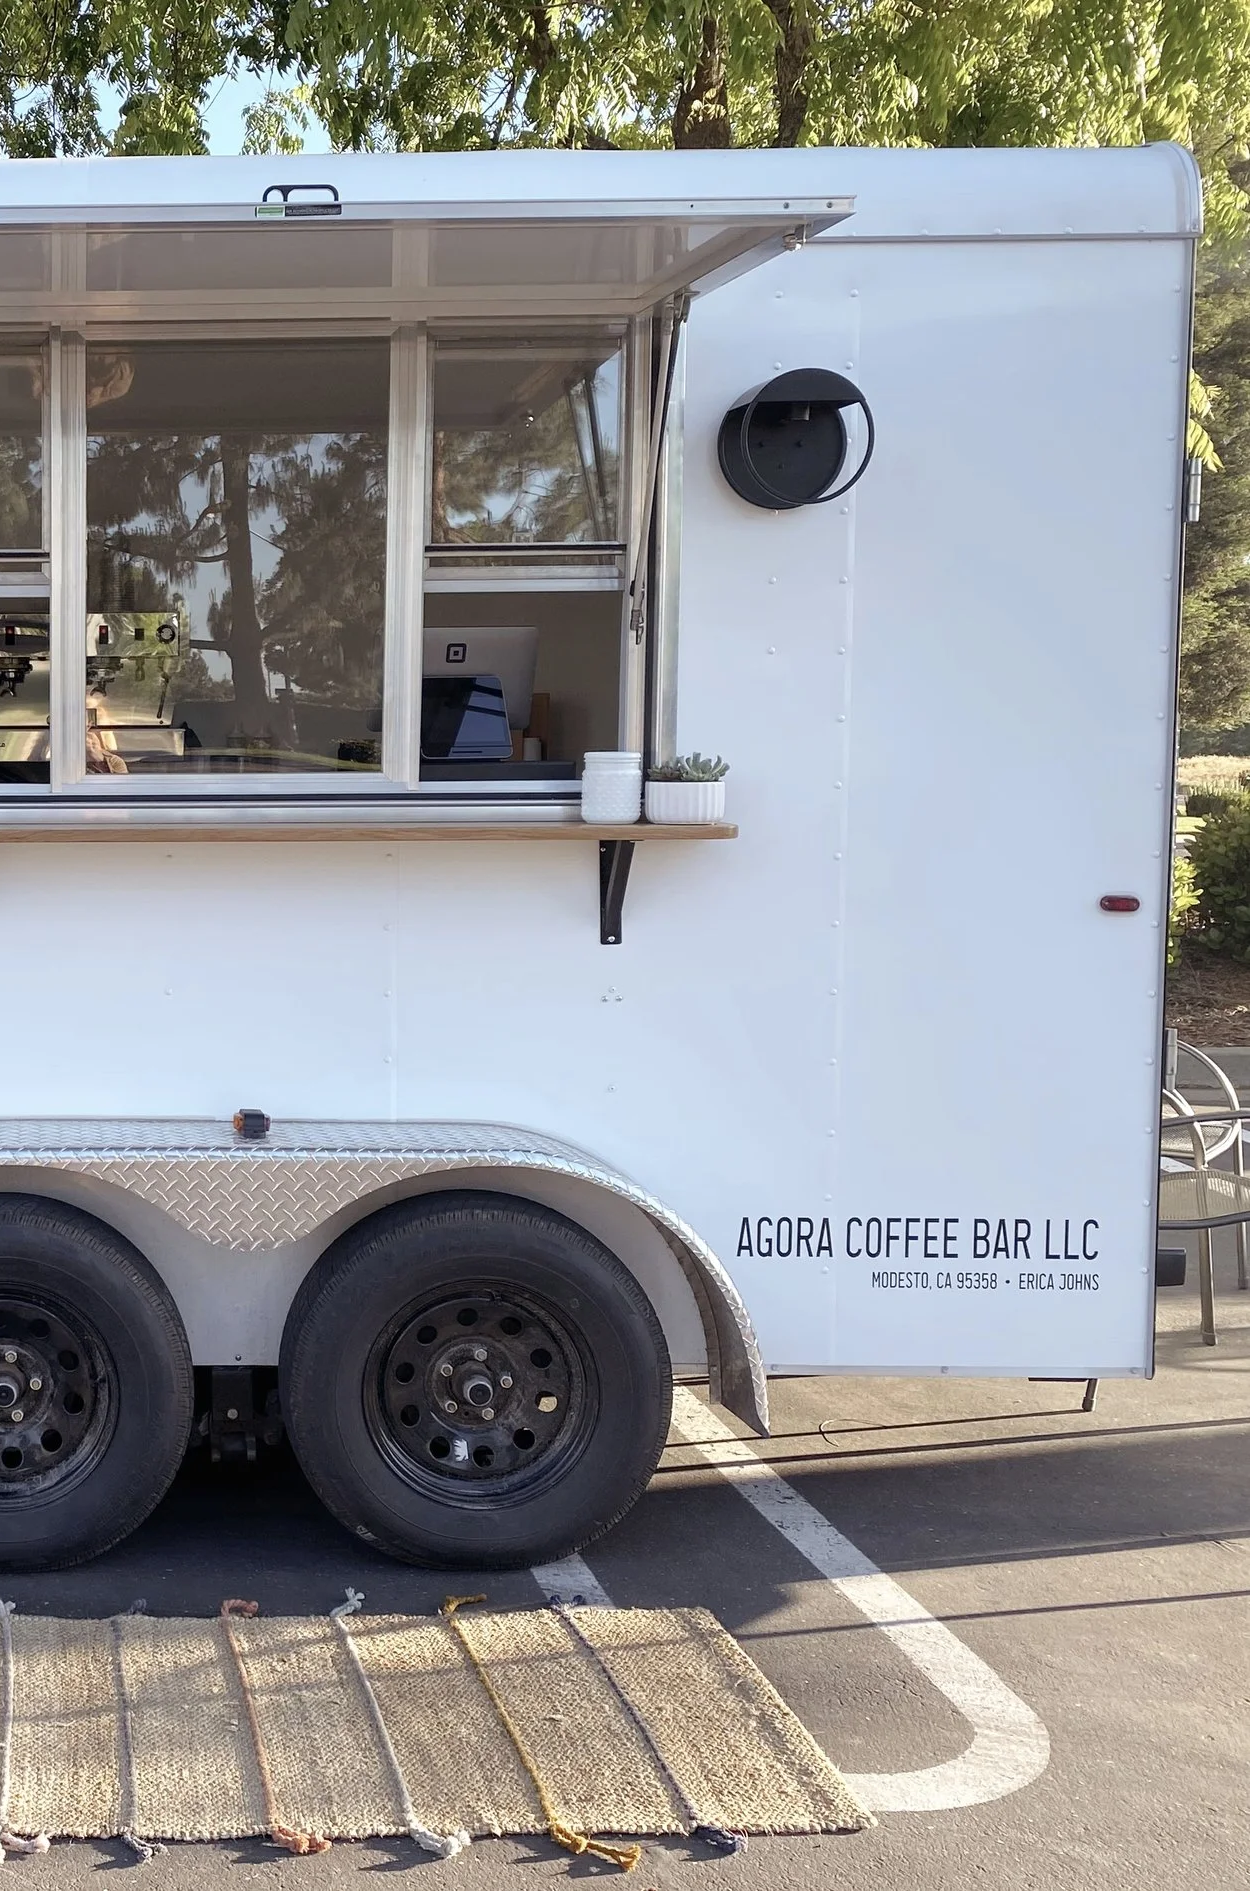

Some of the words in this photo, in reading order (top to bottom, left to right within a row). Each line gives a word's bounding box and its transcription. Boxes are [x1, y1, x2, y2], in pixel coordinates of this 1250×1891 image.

[737, 1217, 833, 1257] AGORA
[846, 1217, 959, 1258] COFFEE
[973, 1219, 1031, 1259] BAR
[1045, 1219, 1099, 1260] LLC
[872, 1272, 931, 1290] MODESTO,
[937, 1272, 952, 1288] CA
[957, 1272, 997, 1289] 95358
[1019, 1273, 1054, 1290] ERICA
[1059, 1274, 1099, 1290] JOHNS
